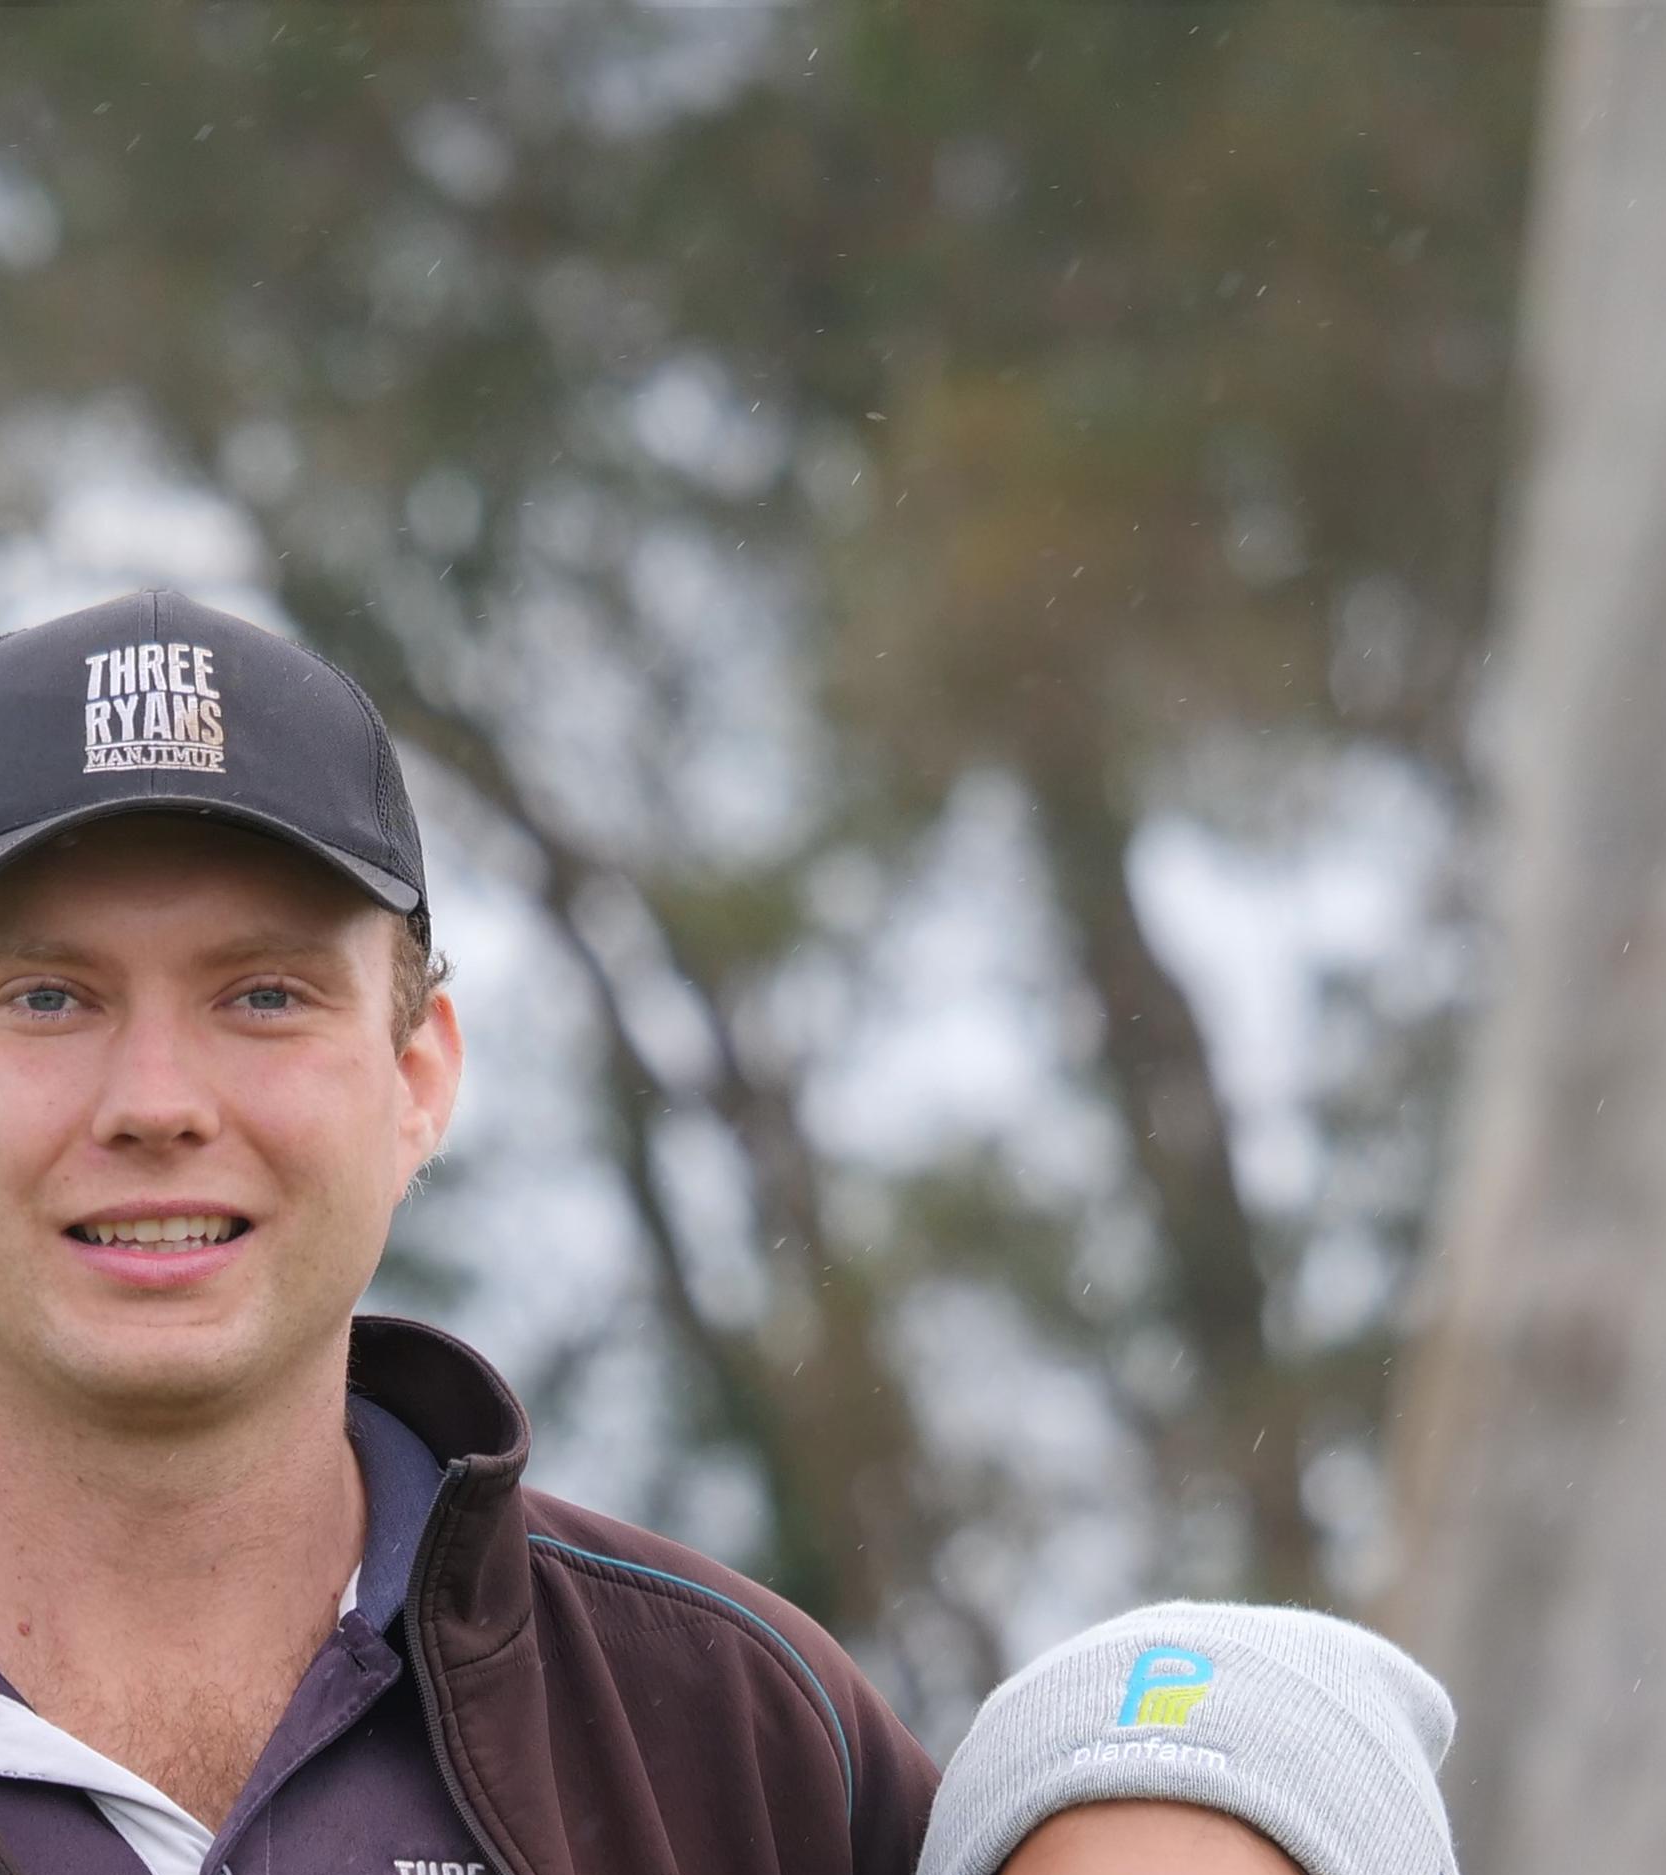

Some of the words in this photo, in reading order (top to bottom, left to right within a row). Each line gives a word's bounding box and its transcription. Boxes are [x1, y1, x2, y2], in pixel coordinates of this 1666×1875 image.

[85, 643, 220, 700] THREE
[85, 691, 224, 746] RYANS
[87, 746, 224, 768] MANJIMUP
[1073, 1736, 1226, 1771] planfarm
